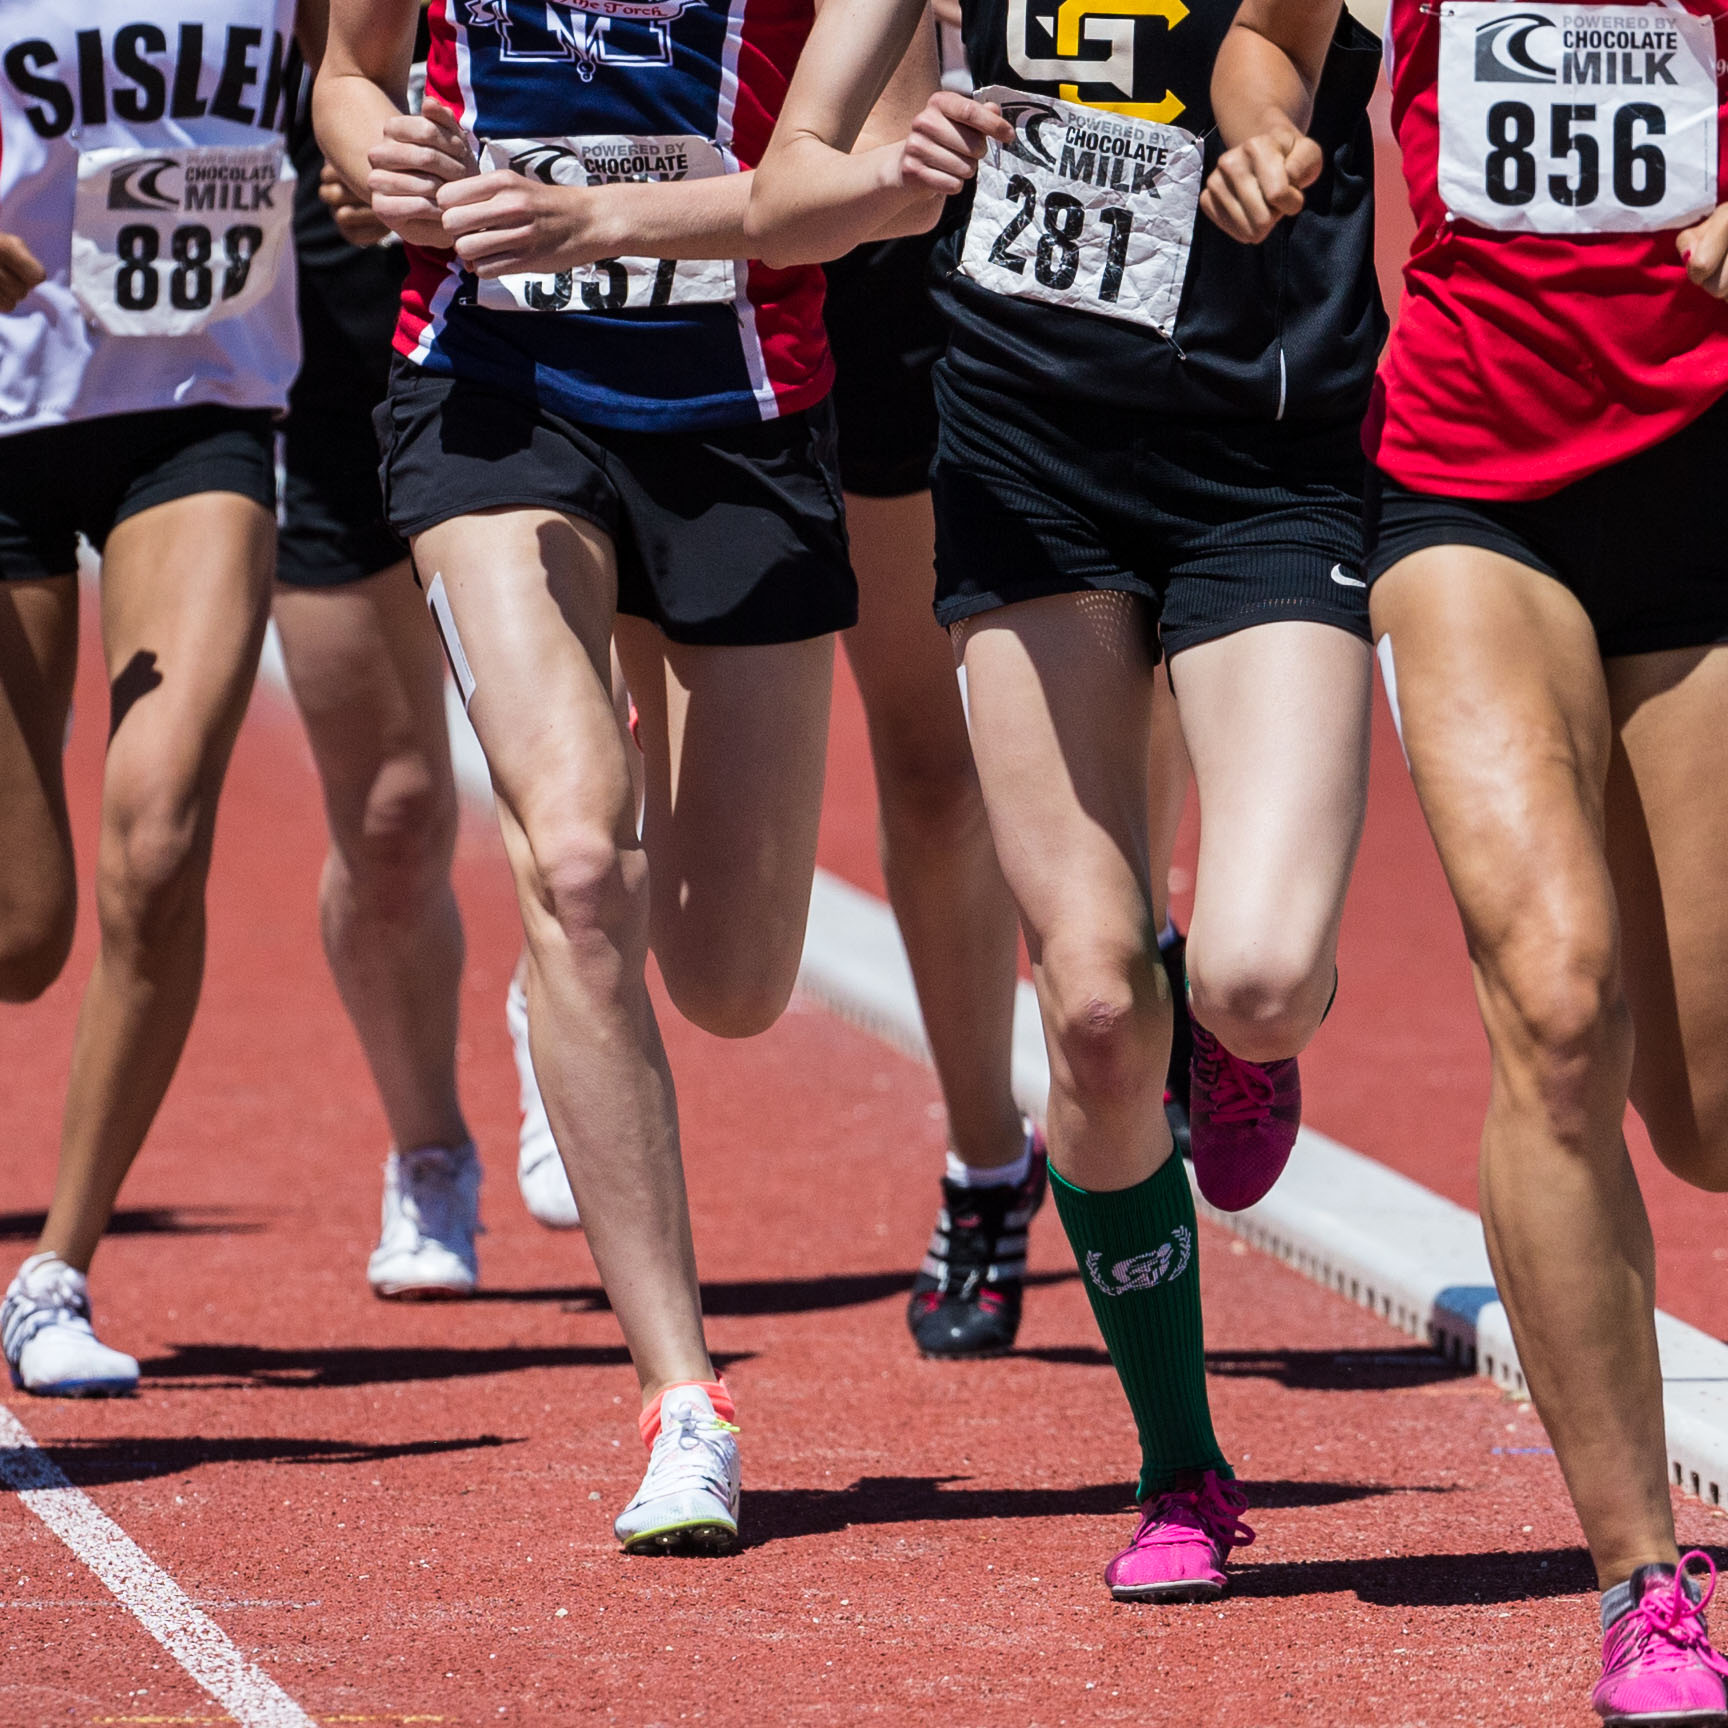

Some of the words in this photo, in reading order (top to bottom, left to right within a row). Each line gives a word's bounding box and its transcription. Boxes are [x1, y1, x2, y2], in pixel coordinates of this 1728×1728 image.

[1563, 15, 1650, 29] POWERED
[1655, 17, 1677, 29] BY
[1563, 30, 1678, 50] CHOCOLATE
[1562, 51, 1679, 85] MILK
[1065, 126, 1169, 166] CHOCOLATE
[1067, 112, 1145, 141] POWERED
[1149, 132, 1172, 148] BY
[582, 144, 660, 158] POWERED
[665, 142, 686, 154] BY
[584, 154, 689, 175] CHOCOLATE
[1485, 101, 1667, 208] 856
[1058, 144, 1165, 200] MILK
[184, 183, 275, 211] MILK
[988, 174, 1134, 304] 281
